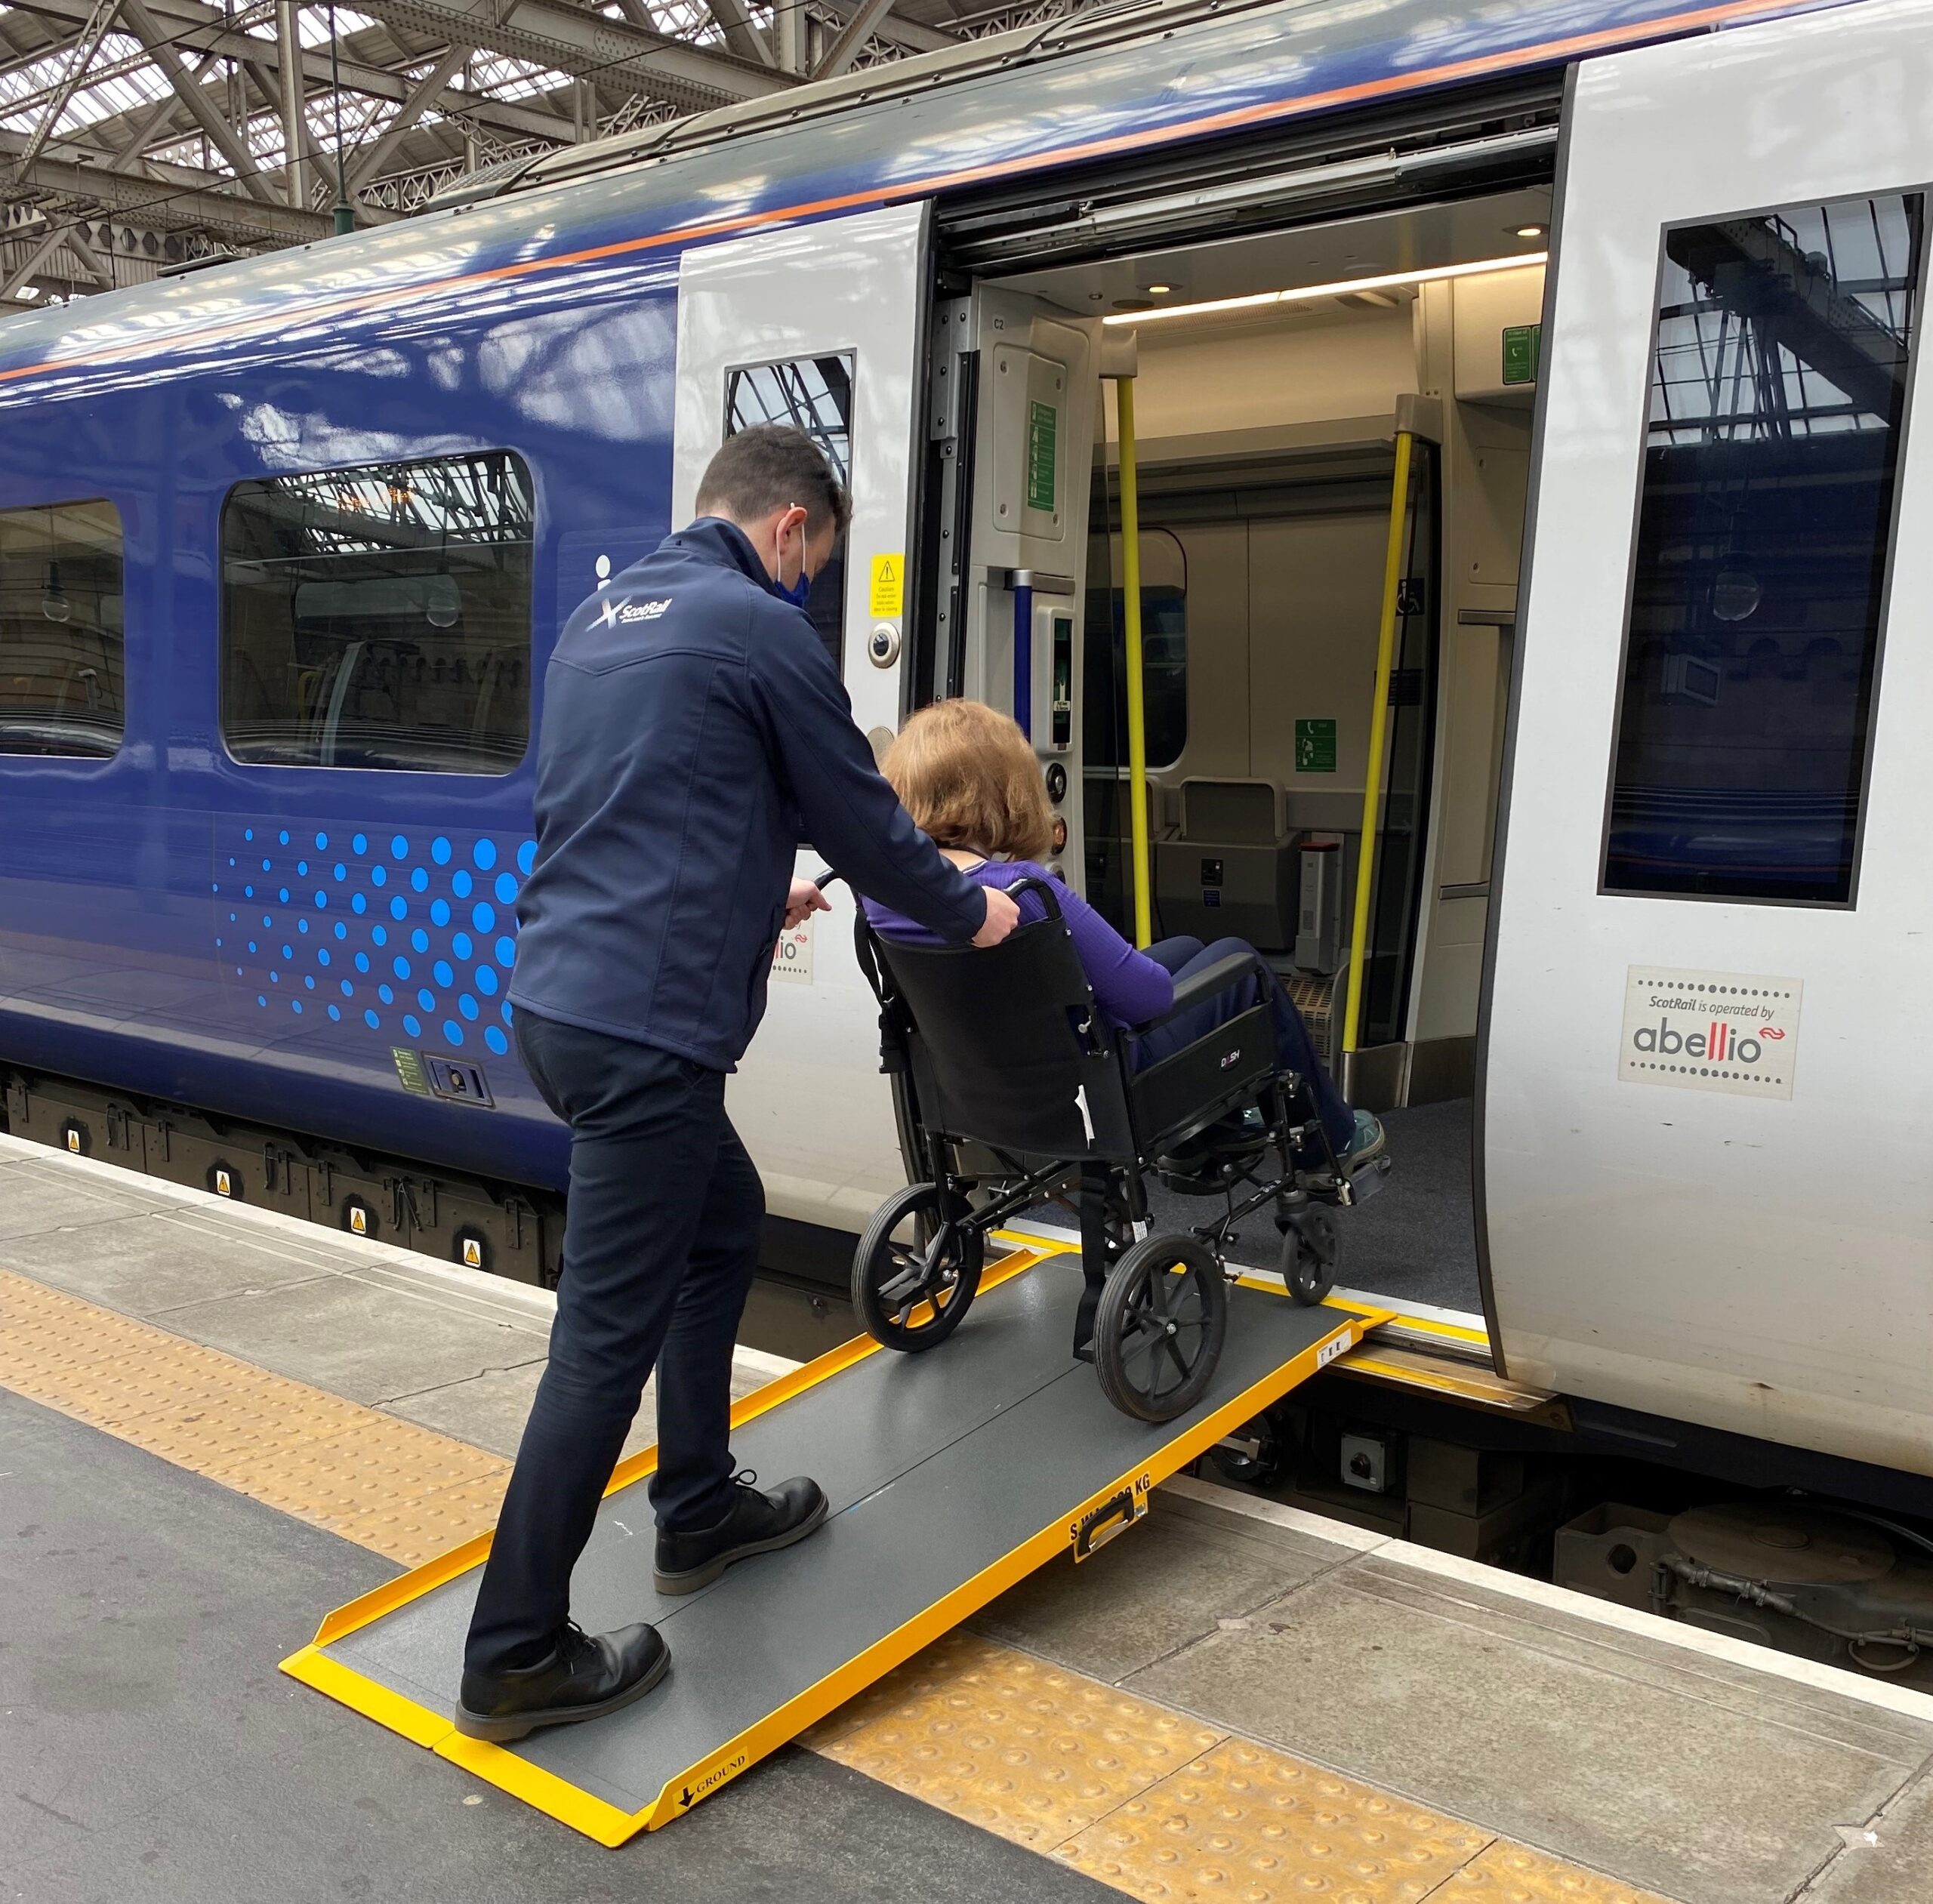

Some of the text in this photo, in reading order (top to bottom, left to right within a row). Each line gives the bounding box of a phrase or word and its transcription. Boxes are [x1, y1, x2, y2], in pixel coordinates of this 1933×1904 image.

[994, 318, 1004, 331] C2
[619, 598, 674, 618] ScotRail
[1648, 995, 1775, 1021] ScotRail is operated by
[1633, 1016, 1762, 1064] abellio
[1135, 1473, 1150, 1496] KG
[696, 1755, 745, 1793] GROUND
